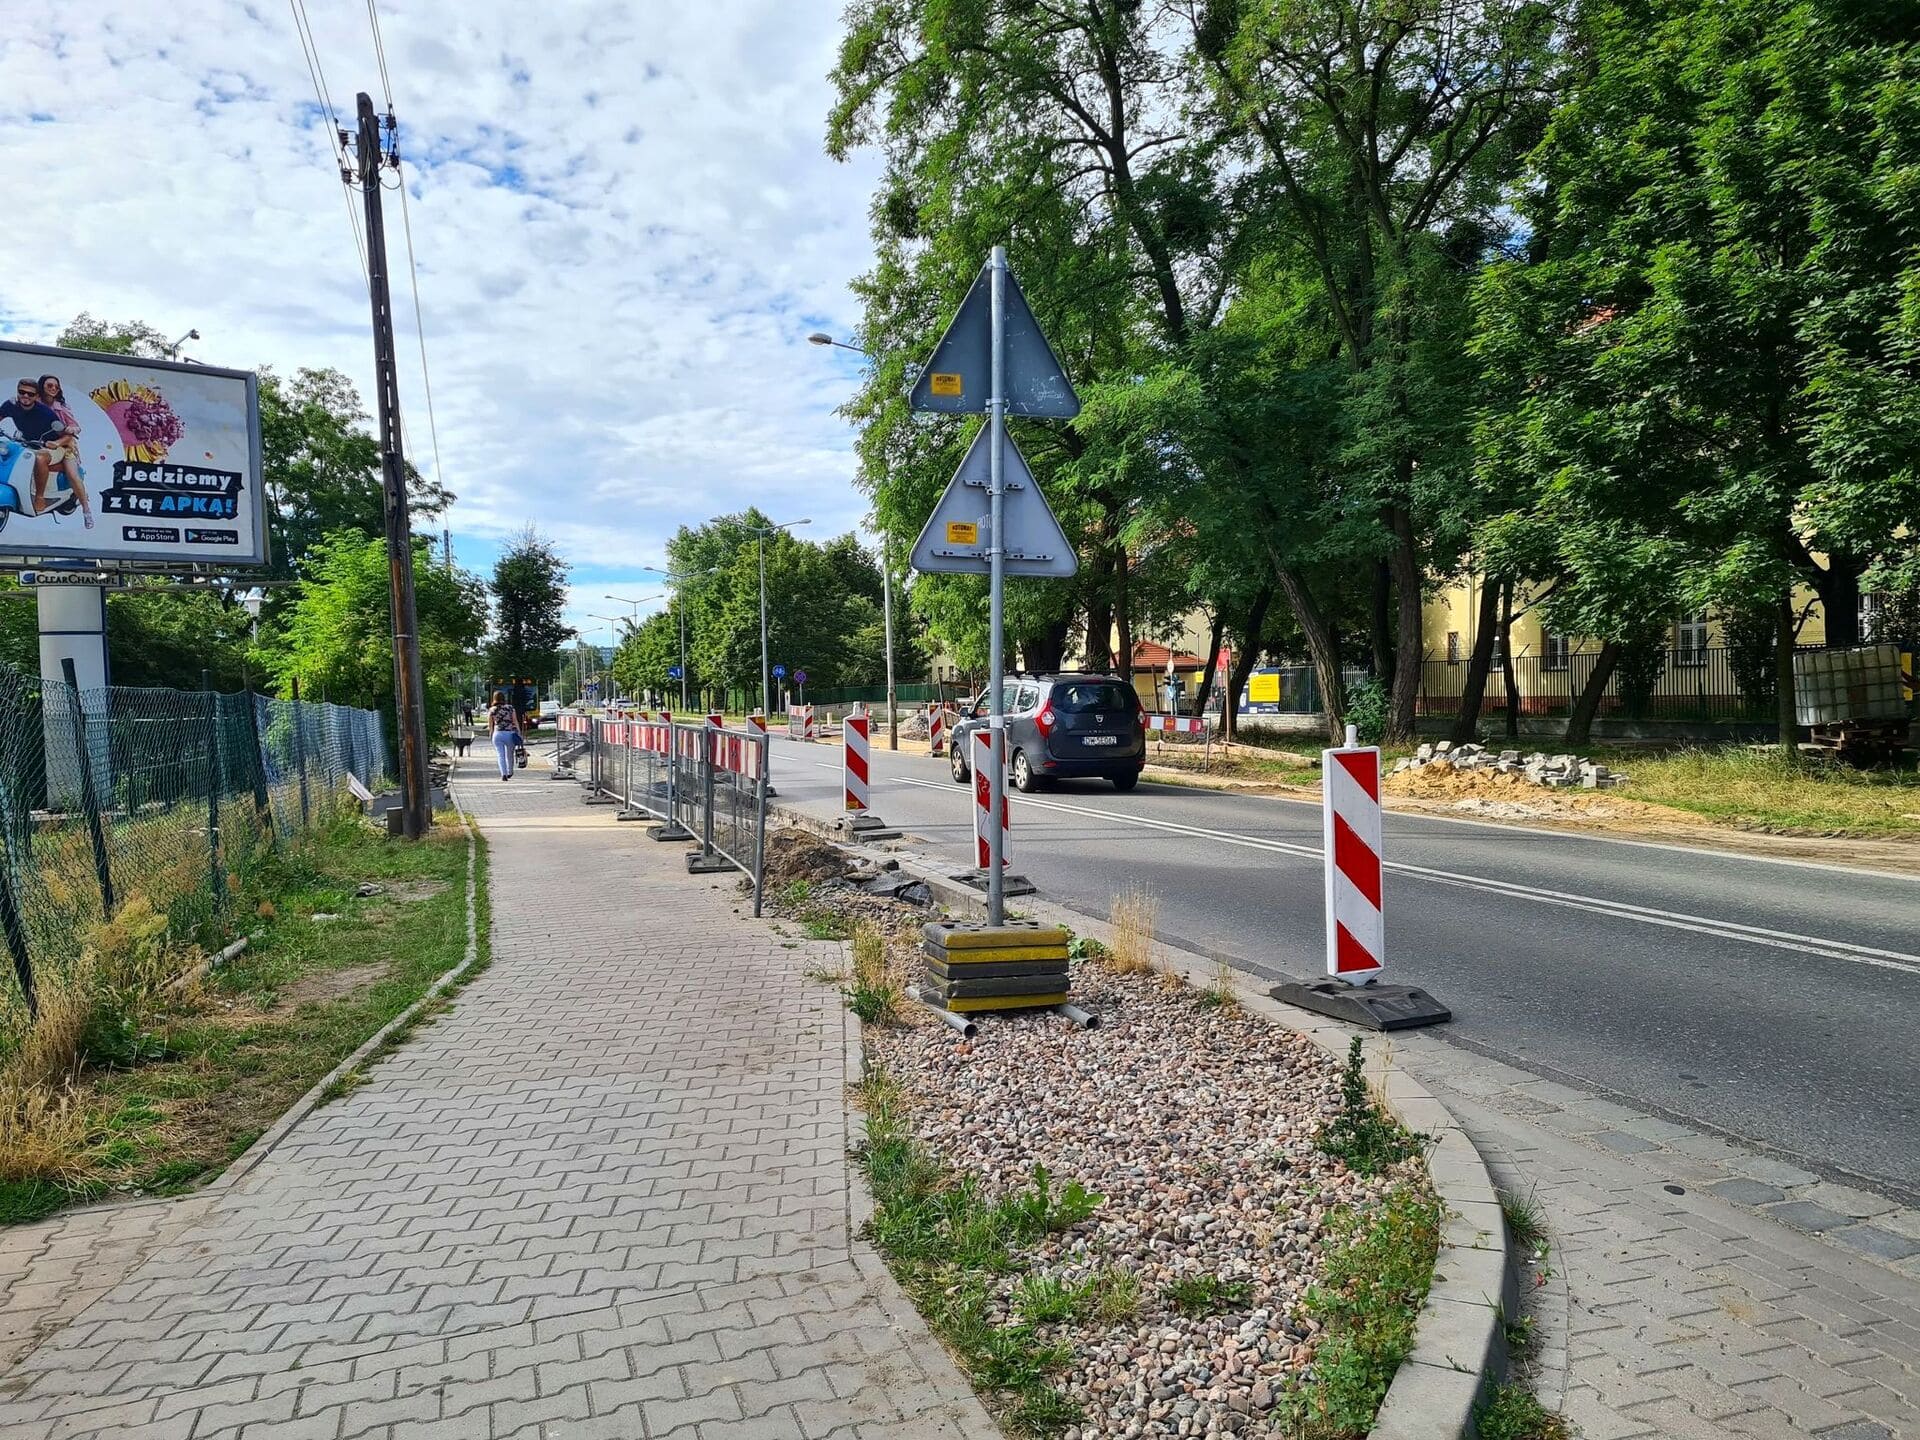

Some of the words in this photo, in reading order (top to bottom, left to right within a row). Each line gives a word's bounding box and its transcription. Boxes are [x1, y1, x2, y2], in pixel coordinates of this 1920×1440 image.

[122, 466, 232, 490] Jedziemy
[110, 497, 121, 508] z
[128, 495, 153, 513] tą
[160, 496, 233, 516] APKĄ!
[141, 533, 155, 541] App
[201, 535, 222, 543] Google
